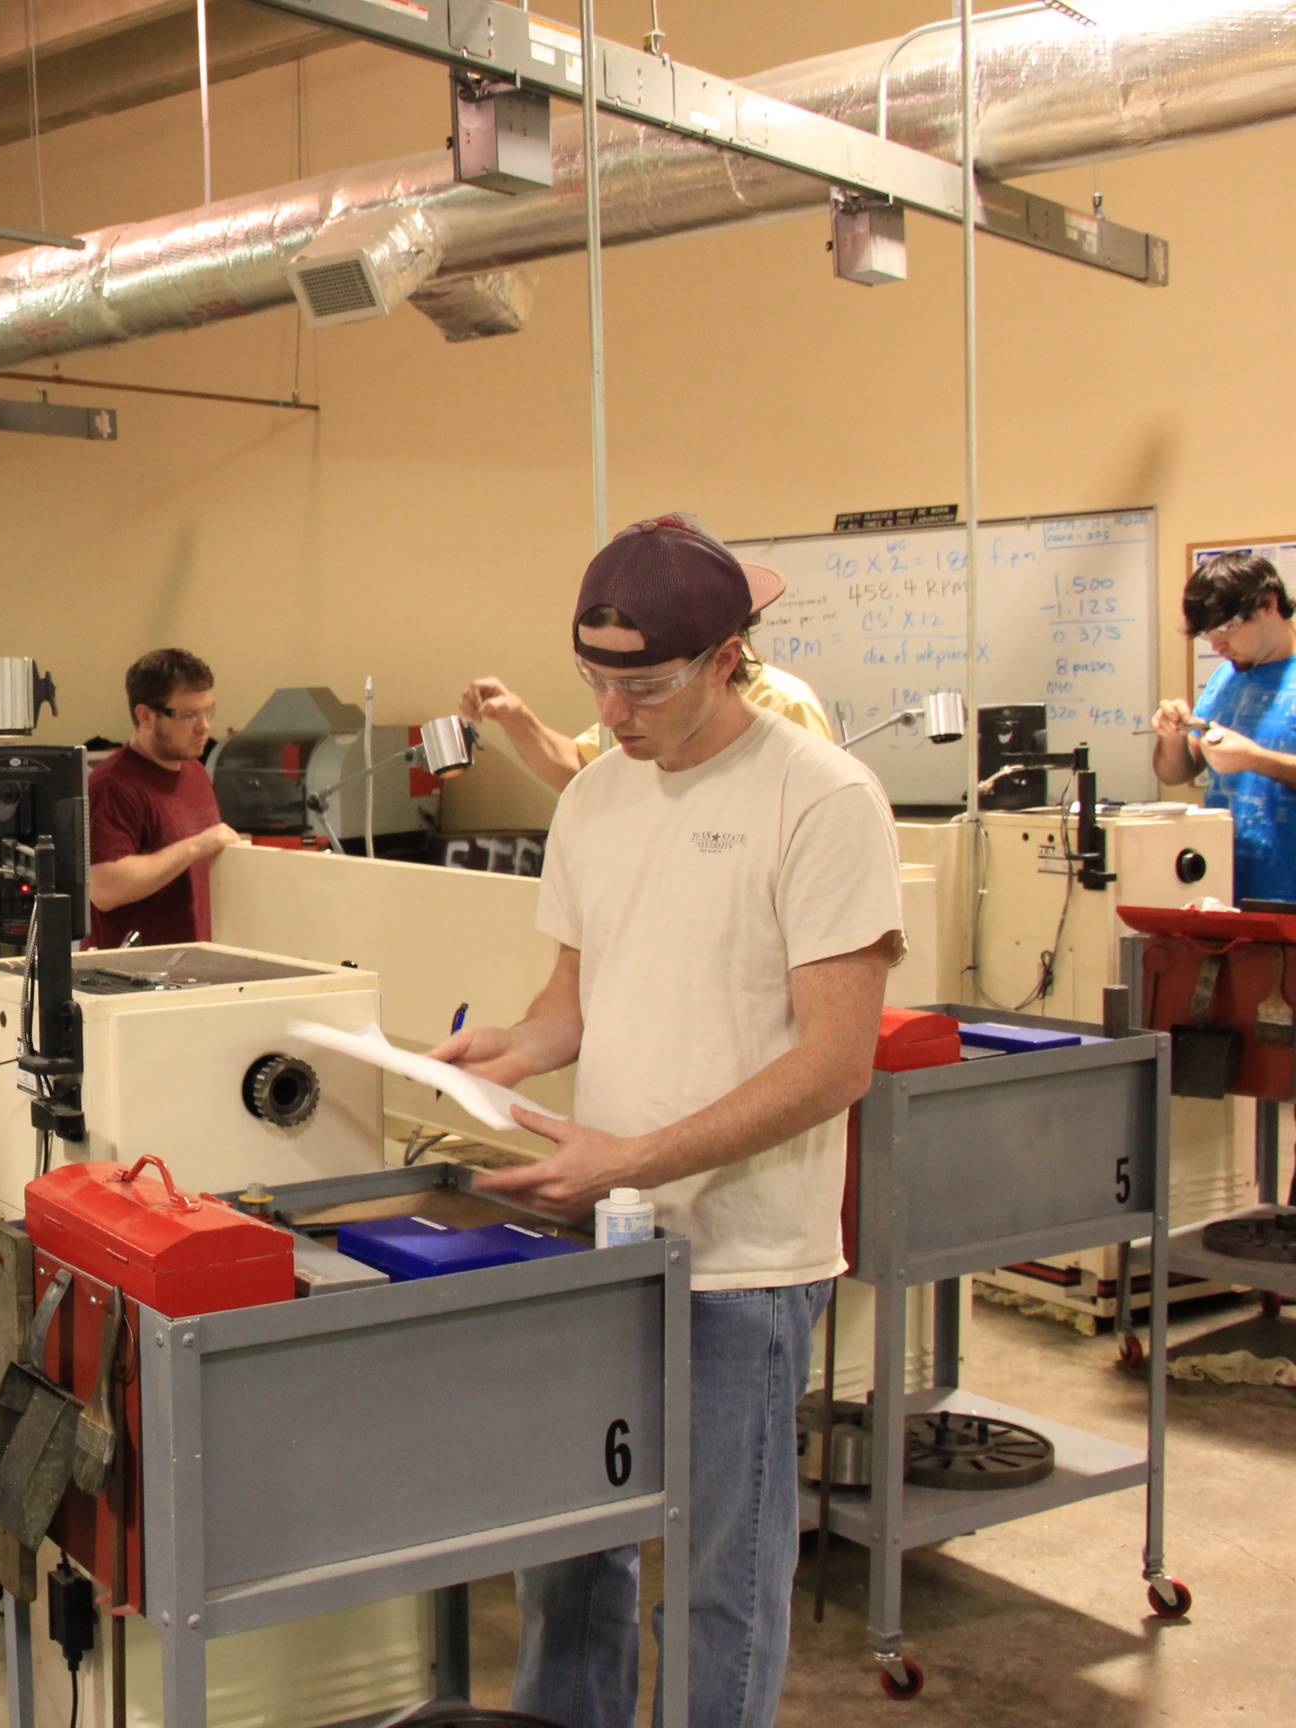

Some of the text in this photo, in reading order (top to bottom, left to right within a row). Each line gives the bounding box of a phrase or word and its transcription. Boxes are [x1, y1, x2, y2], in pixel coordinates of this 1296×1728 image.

[825, 552, 858, 578] 90
[772, 636, 823, 663] RPM
[1115, 1156, 1130, 1204] 5
[605, 1418, 631, 1487] 6
